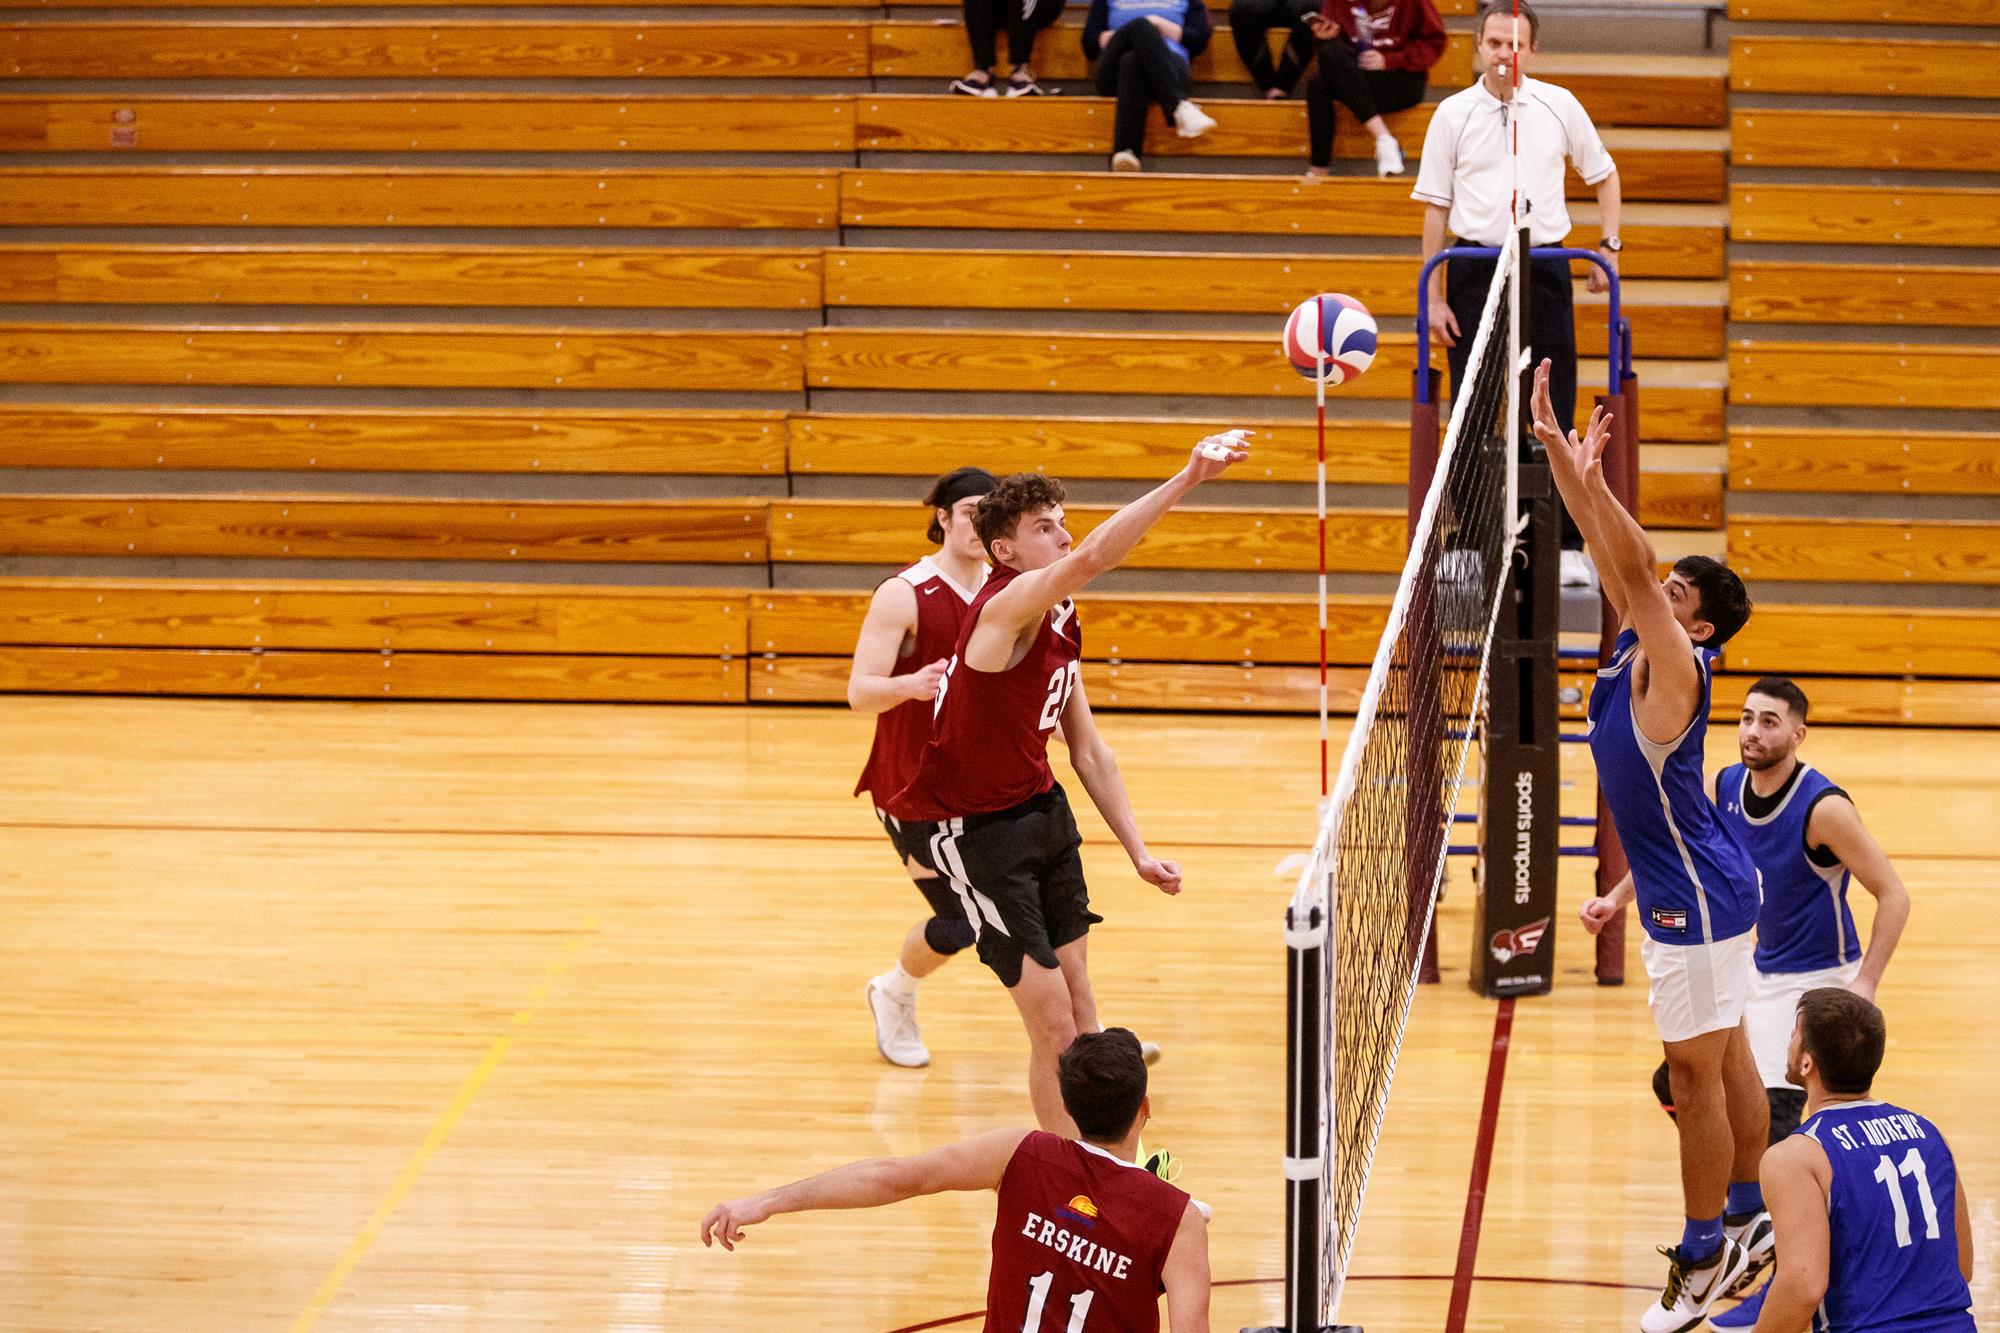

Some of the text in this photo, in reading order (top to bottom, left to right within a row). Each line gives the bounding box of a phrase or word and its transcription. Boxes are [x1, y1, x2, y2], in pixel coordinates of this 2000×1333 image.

[1513, 771, 1533, 904] sports imports
[1831, 1123, 1866, 1151] ST.
[1873, 1147, 1941, 1248] 11
[1021, 1211, 1132, 1280] ERSKINE
